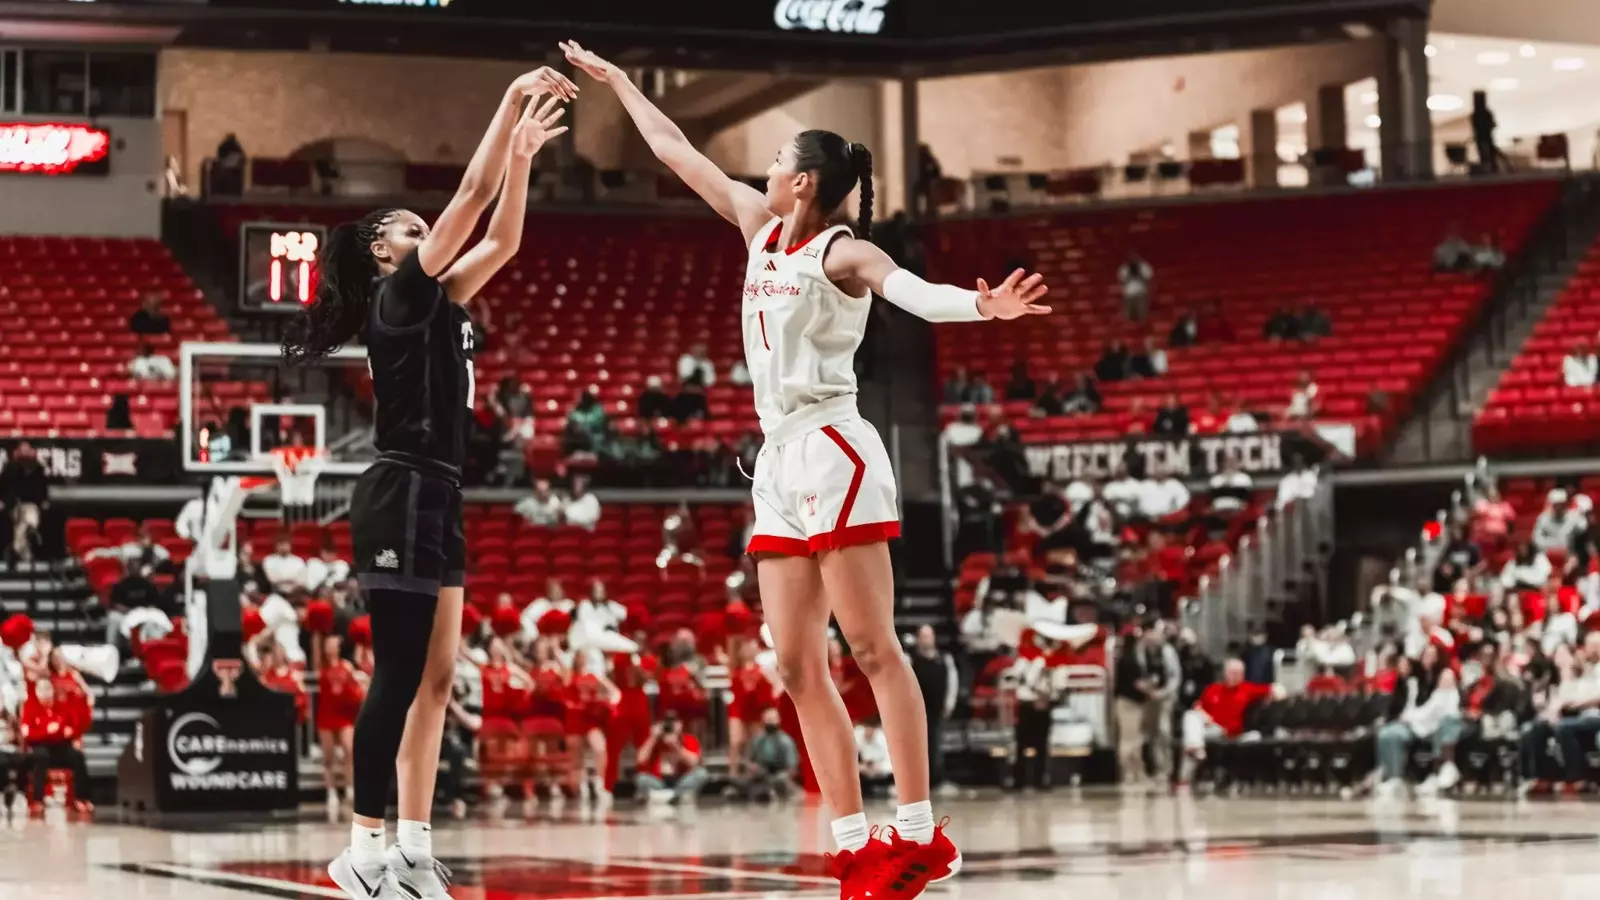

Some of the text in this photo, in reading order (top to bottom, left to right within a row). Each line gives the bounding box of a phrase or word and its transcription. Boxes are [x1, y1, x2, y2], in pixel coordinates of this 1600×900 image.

[758, 310, 771, 351] 1
[1024, 443, 1128, 480] WRECK
[1200, 434, 1282, 474] TECH
[169, 771, 288, 791] WOUNDCARE
